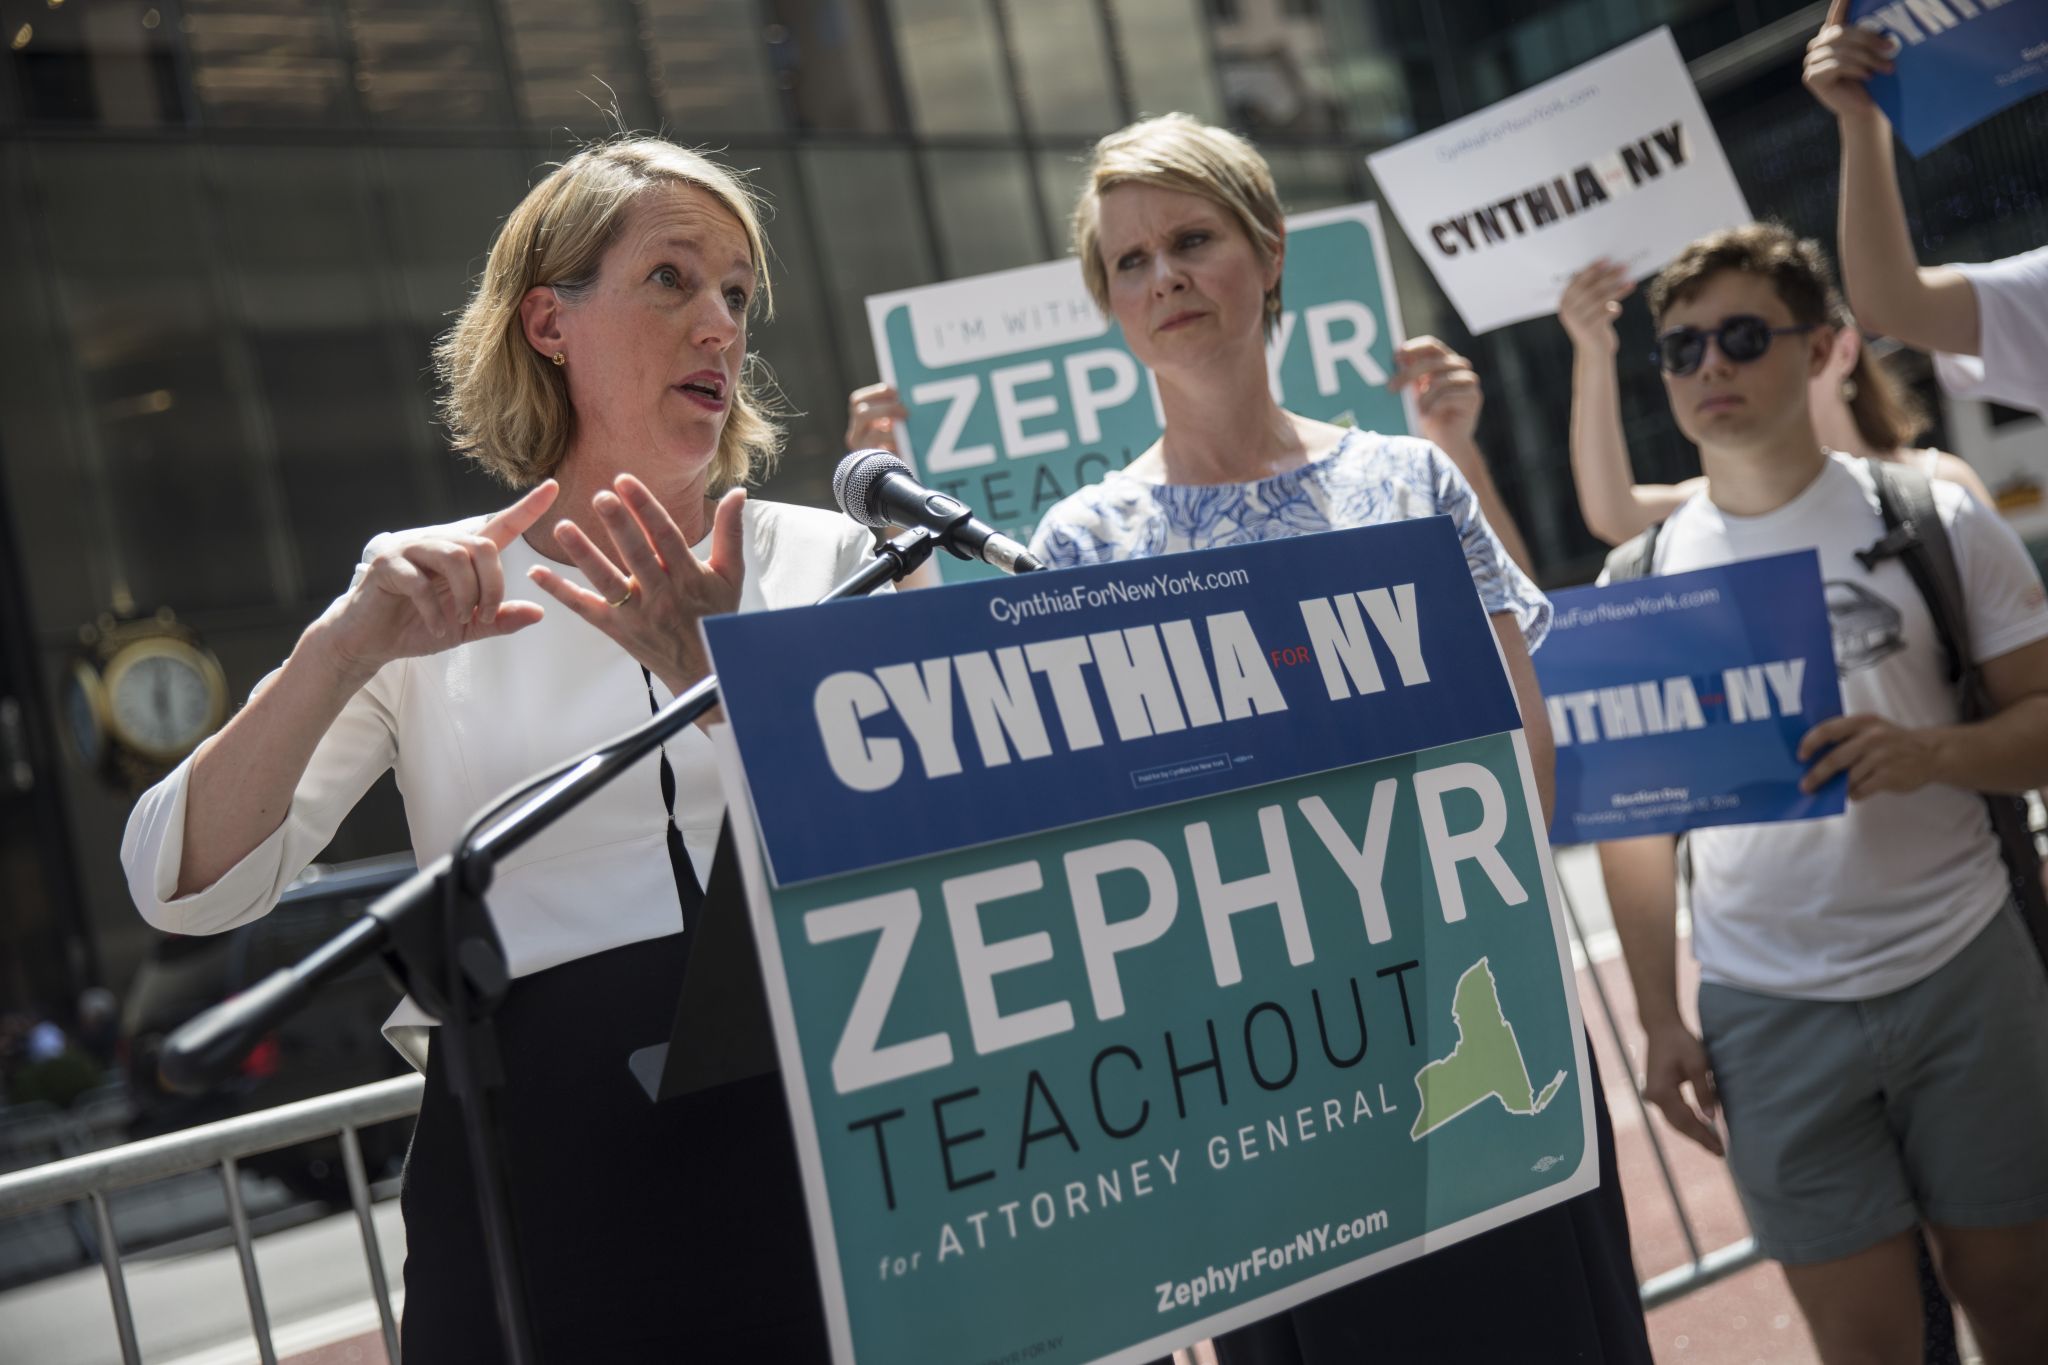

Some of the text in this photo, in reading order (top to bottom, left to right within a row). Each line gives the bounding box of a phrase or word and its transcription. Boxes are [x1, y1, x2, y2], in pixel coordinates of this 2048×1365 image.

[1430, 120, 1685, 255] CYNTHIA NY
[912, 298, 1388, 474] ZEPYR
[933, 299, 1090, 348] I'M WITH
[937, 447, 1132, 522] TEAC
[991, 566, 1249, 624] CynthiaForNewYork.com
[813, 583, 1430, 793] CYNTHIA FOR NY
[1722, 657, 1806, 724] NY
[804, 761, 1529, 1094] ZEPHYR
[848, 960, 1420, 1210] TEACHOUT
[879, 1082, 1397, 1280] for ATTORNEY GENERAL
[1156, 1205, 1389, 1313] ZephyrForNY.com
